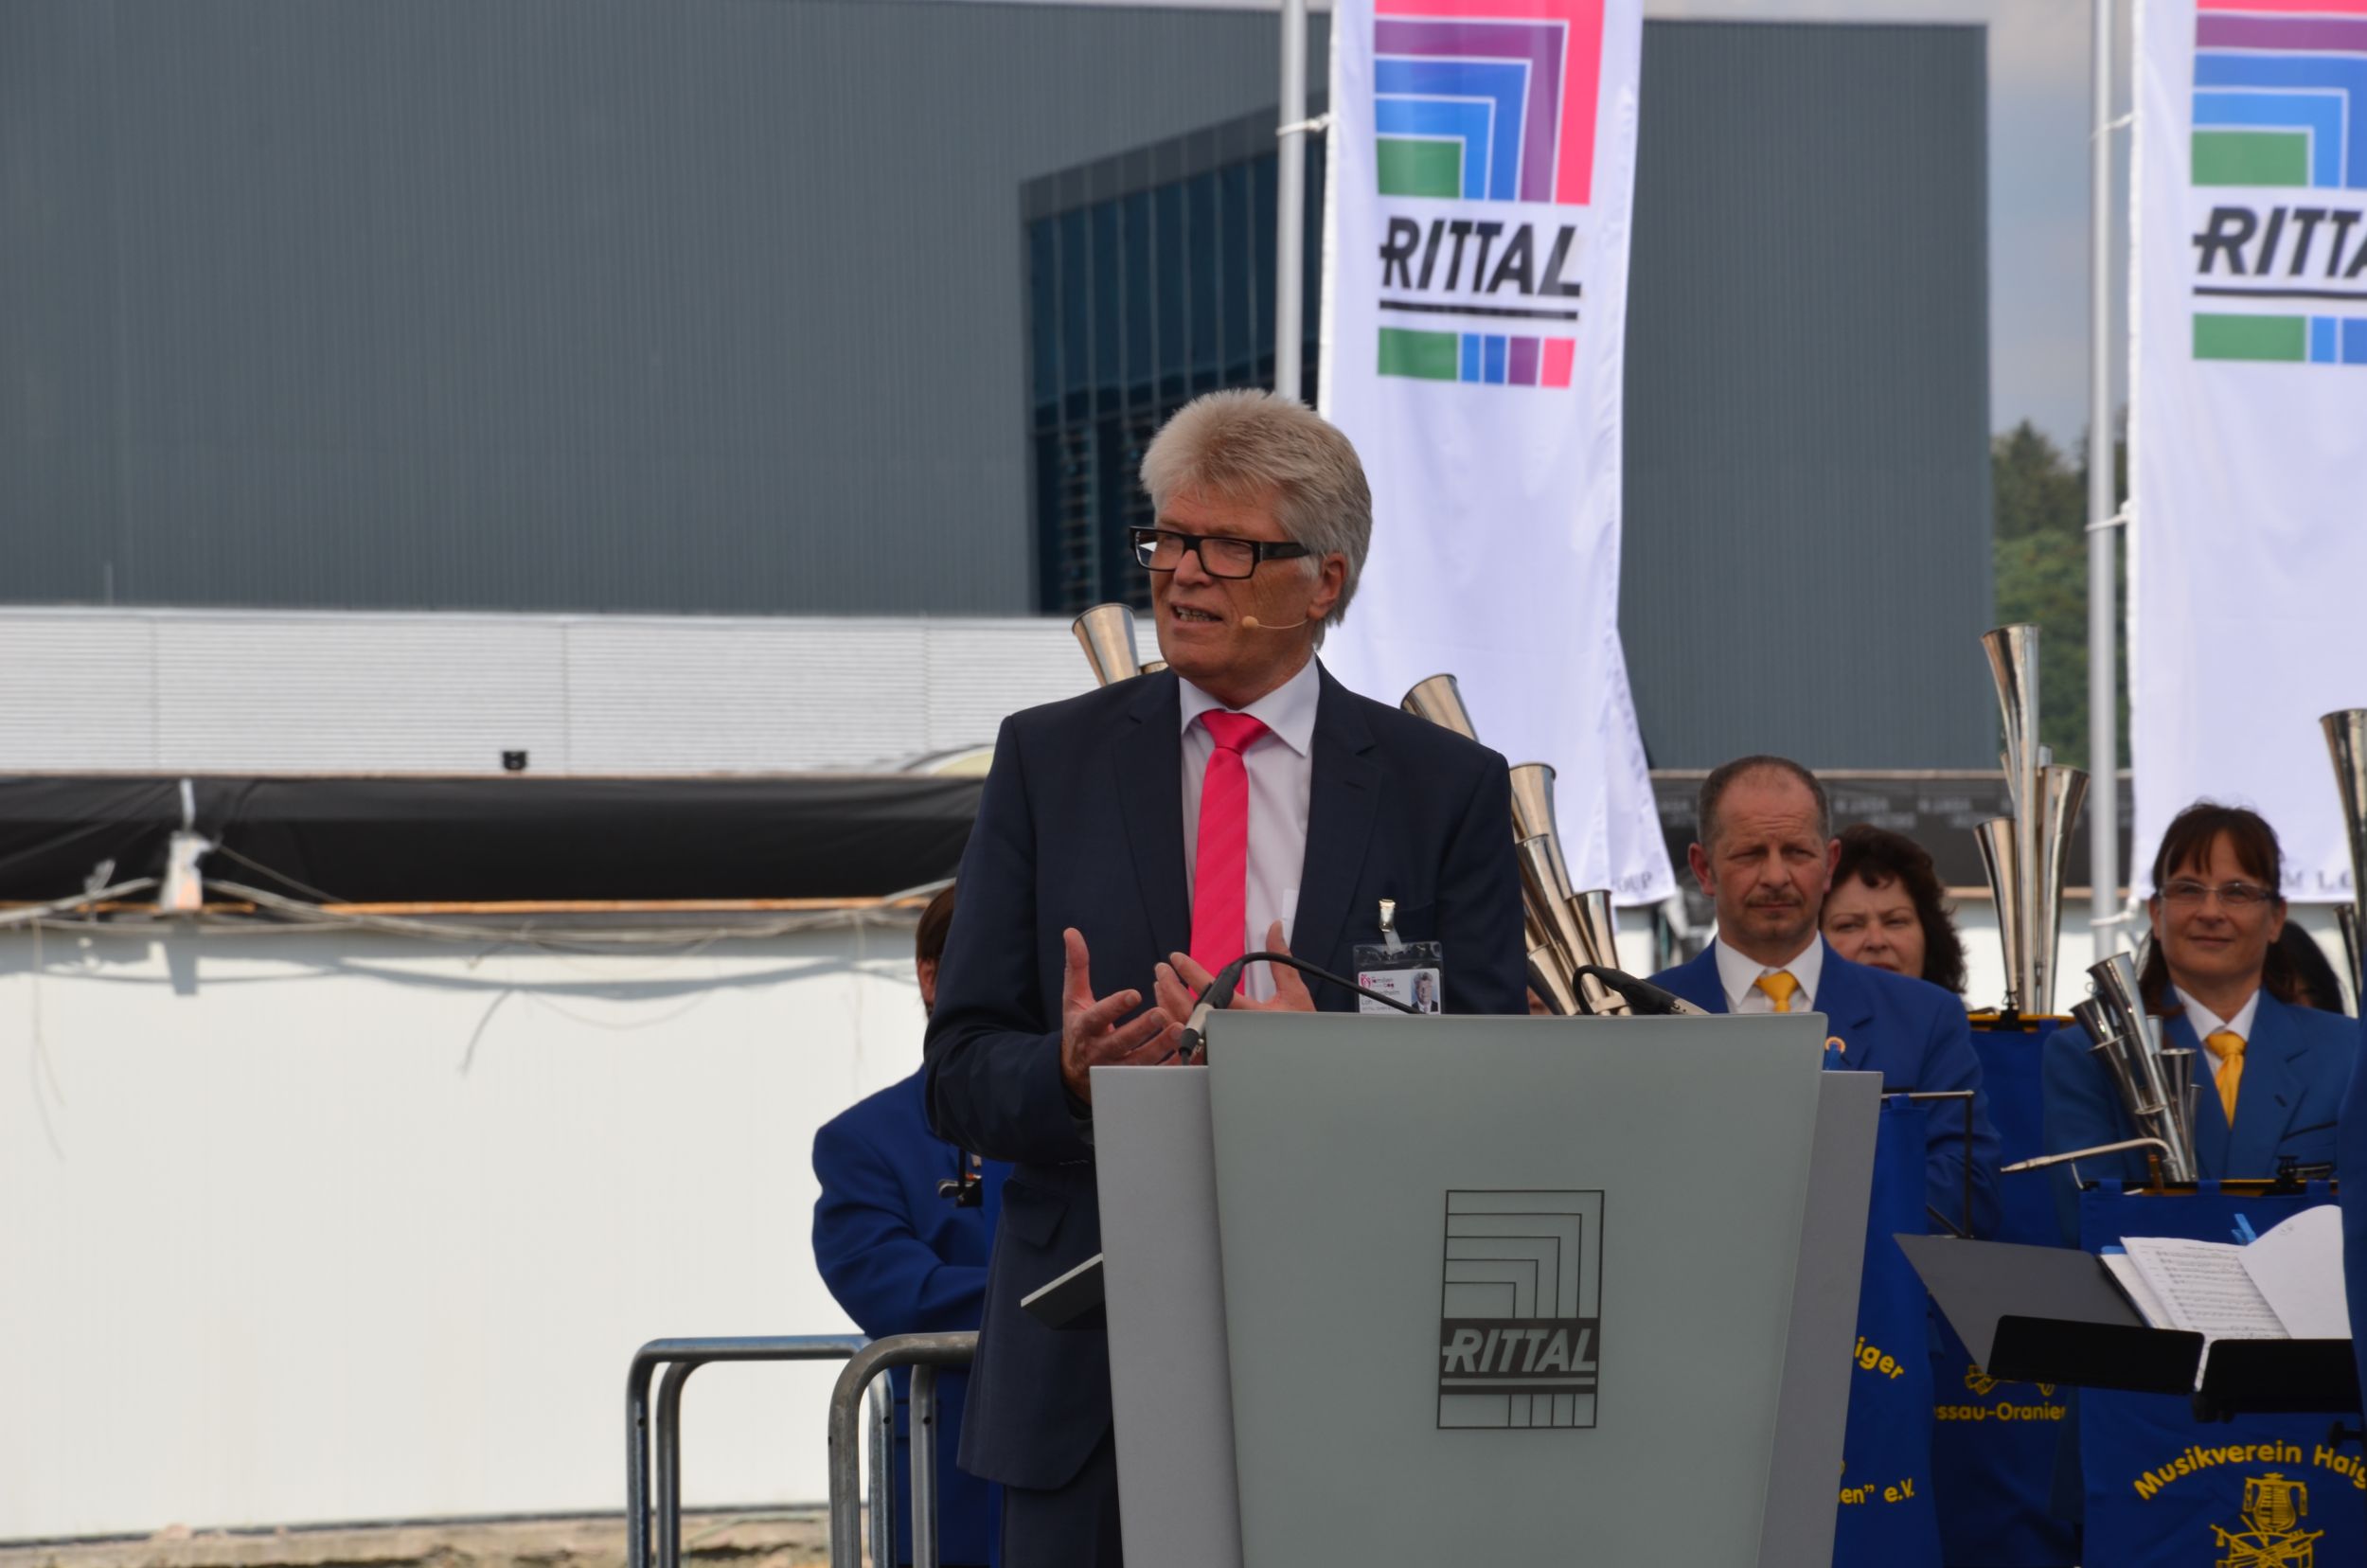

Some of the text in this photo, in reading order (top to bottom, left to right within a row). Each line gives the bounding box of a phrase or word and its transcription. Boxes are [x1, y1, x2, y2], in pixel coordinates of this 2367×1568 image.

[1379, 214, 1582, 298] RITTAL
[1442, 1327, 1597, 1373] RITTAL
[2132, 1438, 2304, 1501] Musikverein
